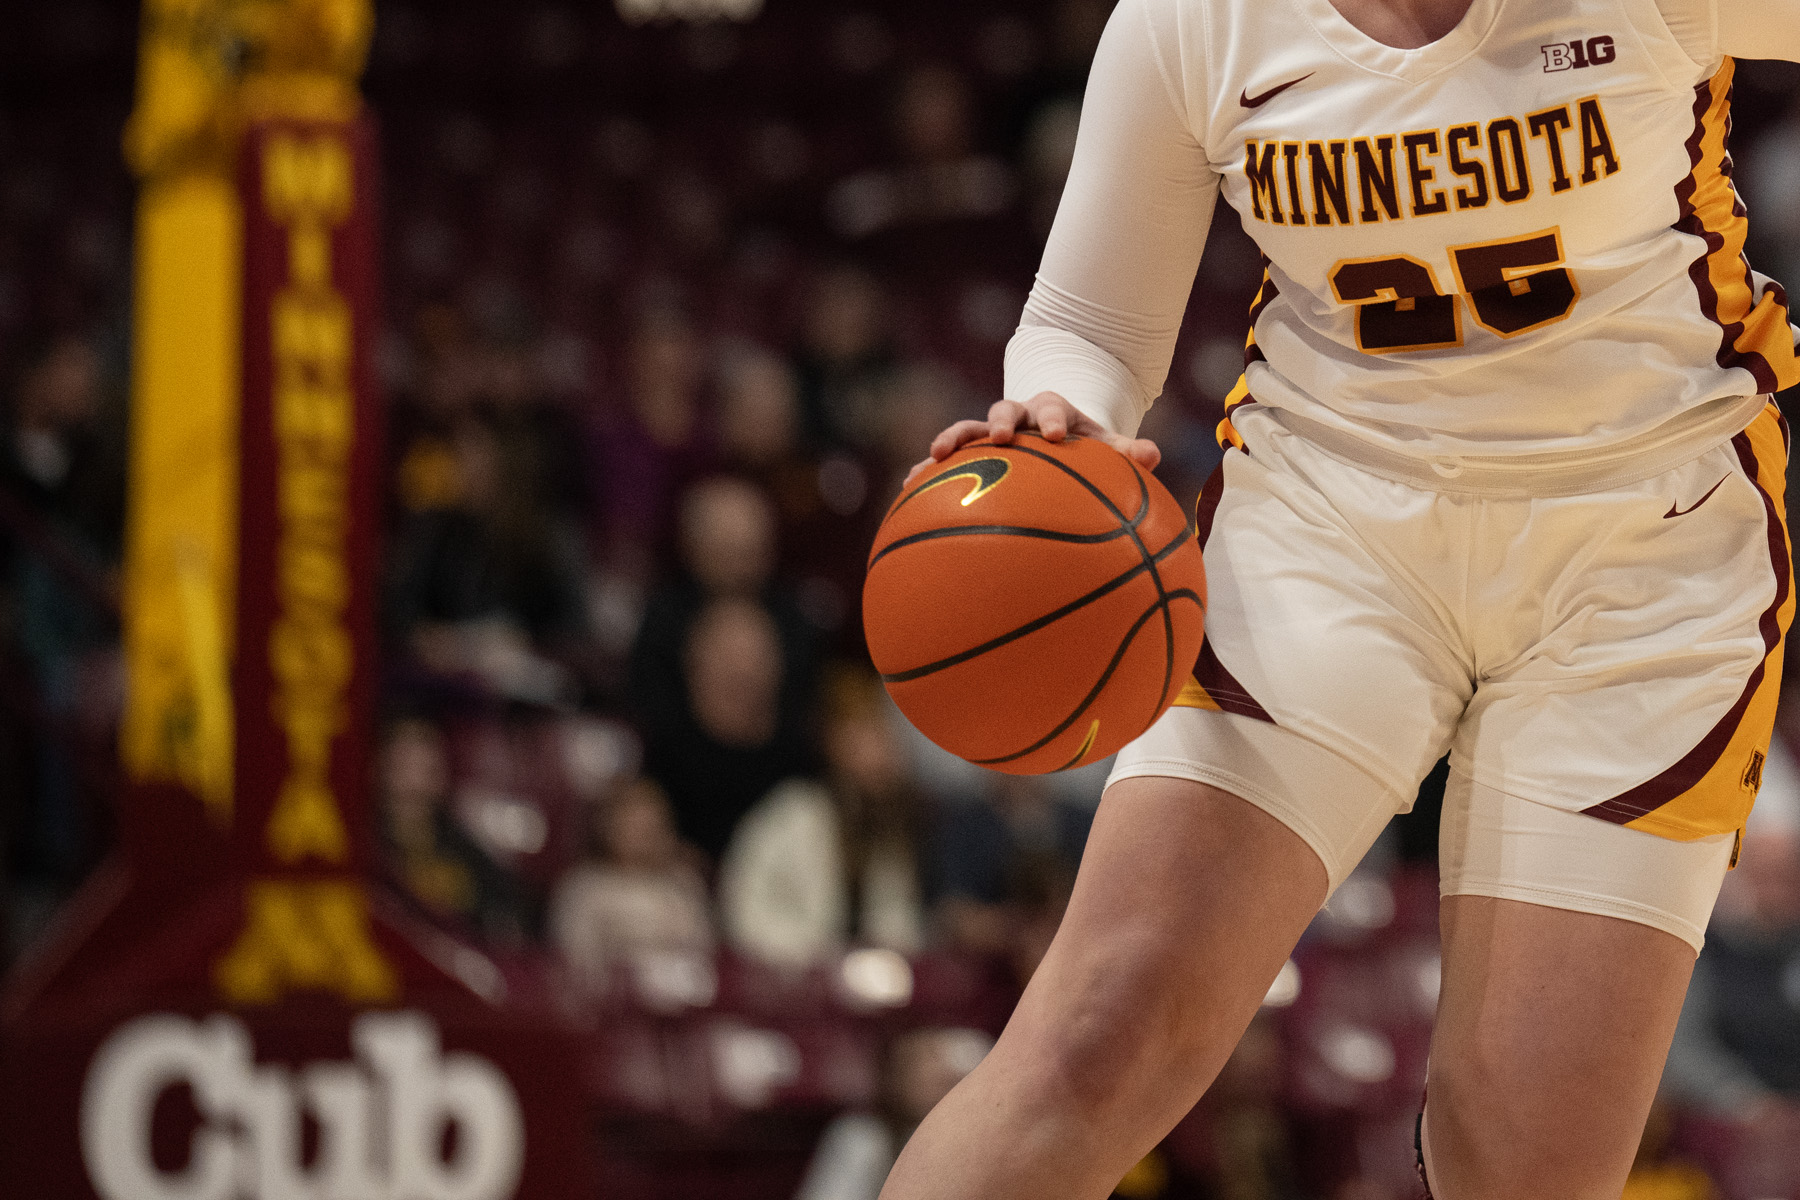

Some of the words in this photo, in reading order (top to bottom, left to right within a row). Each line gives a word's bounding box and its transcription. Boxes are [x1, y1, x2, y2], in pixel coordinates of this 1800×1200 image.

[1243, 94, 1622, 228] MINNESOTA
[1327, 226, 1581, 356] 25
[79, 1012, 527, 1200] Cub
